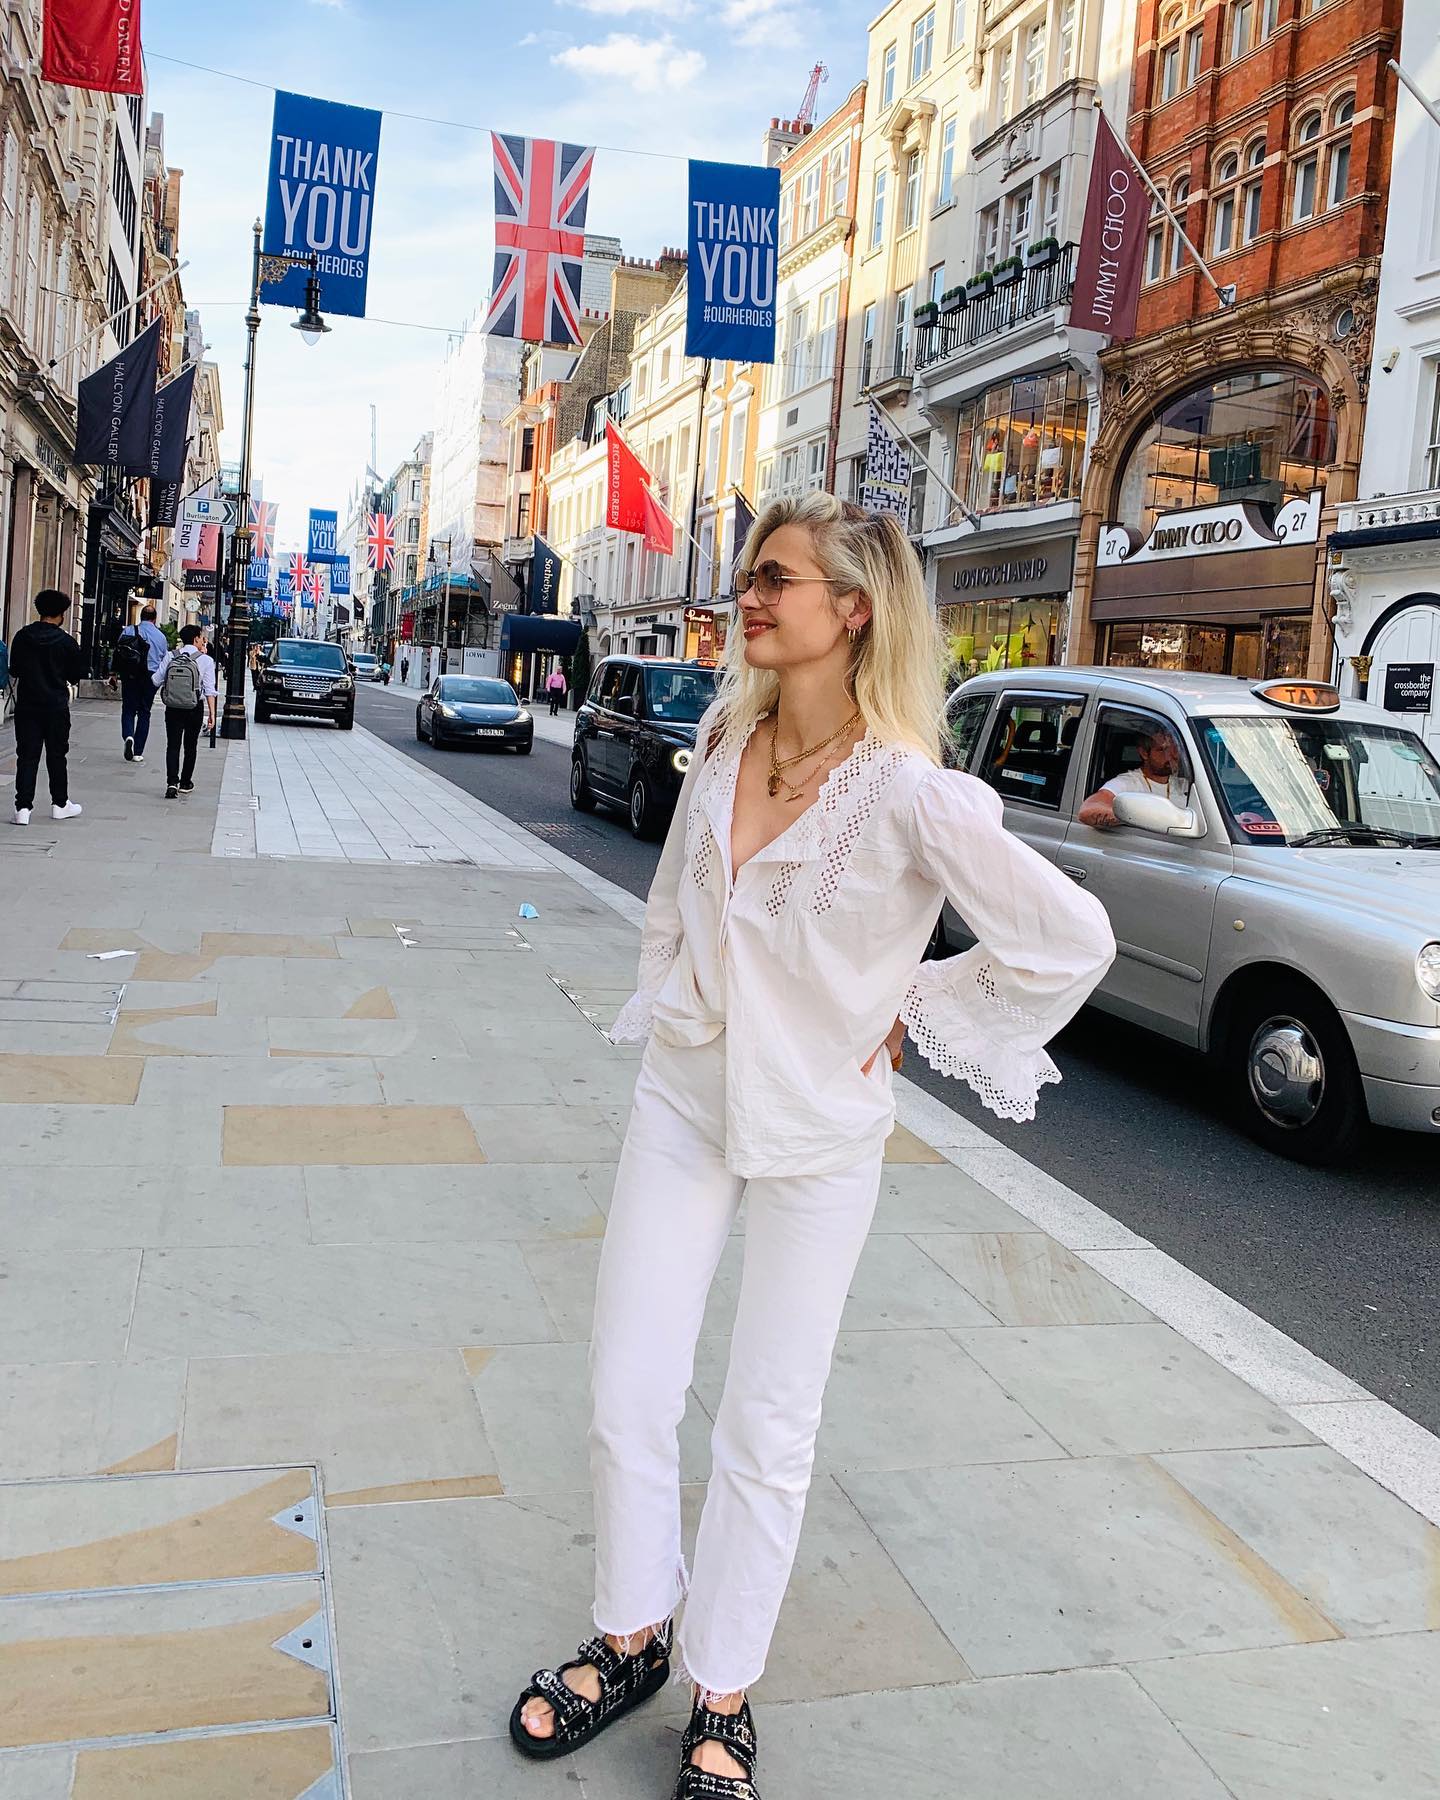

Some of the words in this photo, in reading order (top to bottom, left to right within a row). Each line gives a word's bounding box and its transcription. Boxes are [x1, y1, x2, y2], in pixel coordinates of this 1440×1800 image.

[117, 17, 131, 83] GREEN
[277, 135, 374, 191] THANK
[279, 179, 369, 256] YOU
[693, 201, 776, 246] THANK
[1102, 169, 1130, 251] CHOO
[697, 241, 774, 308] YOU
[1091, 254, 1119, 325] JIMMY
[703, 305, 772, 328] #OURHEROES
[112, 361, 125, 414] HALCYON
[154, 398, 164, 437] HALCYON
[108, 417, 121, 462] GALLERY
[150, 440, 160, 475] GALLERY
[612, 443, 620, 489] RICHARD
[186, 512, 220, 521] Burlington
[611, 490, 620, 525] GREEN
[1291, 512, 1308, 532] 27
[180, 522, 192, 548] ENDI
[310, 518, 337, 532] THANK
[311, 530, 336, 549] YOU
[1149, 525, 1190, 551] JIMMY
[1191, 518, 1243, 546] CHOO
[1105, 539, 1117, 556] 27
[250, 563, 268, 578] YOU
[332, 570, 349, 584] YOU
[541, 557, 554, 601] Sotheby's
[953, 557, 1048, 591] LONGCHAMP
[492, 600, 518, 611] Zegna
[1394, 680, 1431, 690] crossborder
[1400, 689, 1430, 699] company
[1420, 673, 1431, 683] the
